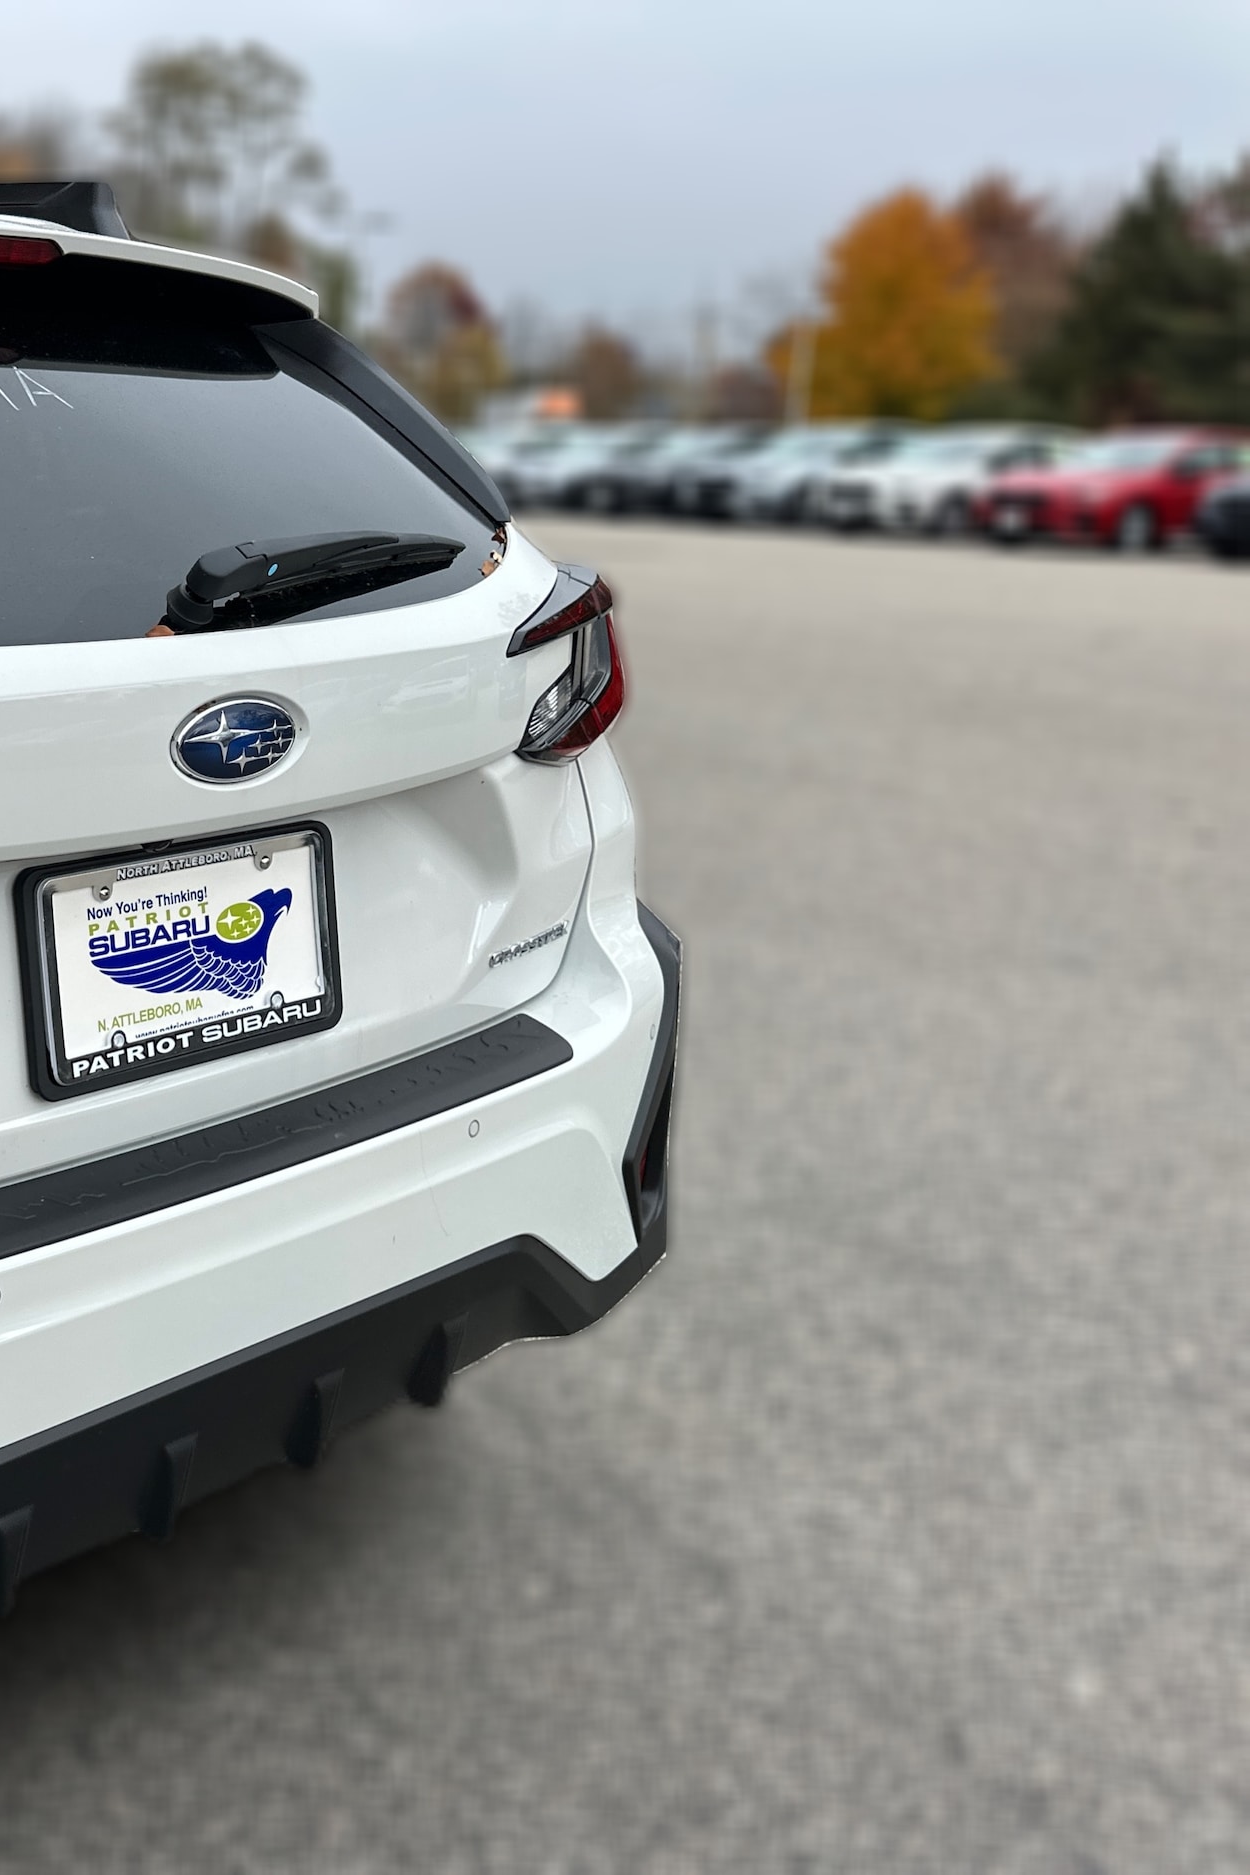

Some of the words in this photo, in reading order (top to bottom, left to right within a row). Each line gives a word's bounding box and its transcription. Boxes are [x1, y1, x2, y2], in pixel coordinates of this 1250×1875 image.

[87, 906, 113, 920] Now
[116, 899, 154, 915] You're
[156, 886, 208, 907] Thinking!
[88, 902, 209, 936] PATRIOT
[88, 915, 211, 957] SUBARU
[97, 1020, 110, 1033] N.
[111, 1002, 184, 1029] ATTLEBORO,
[185, 996, 203, 1012] MA
[71, 1031, 194, 1079] PATRIOT
[201, 999, 323, 1044] SUBARU
